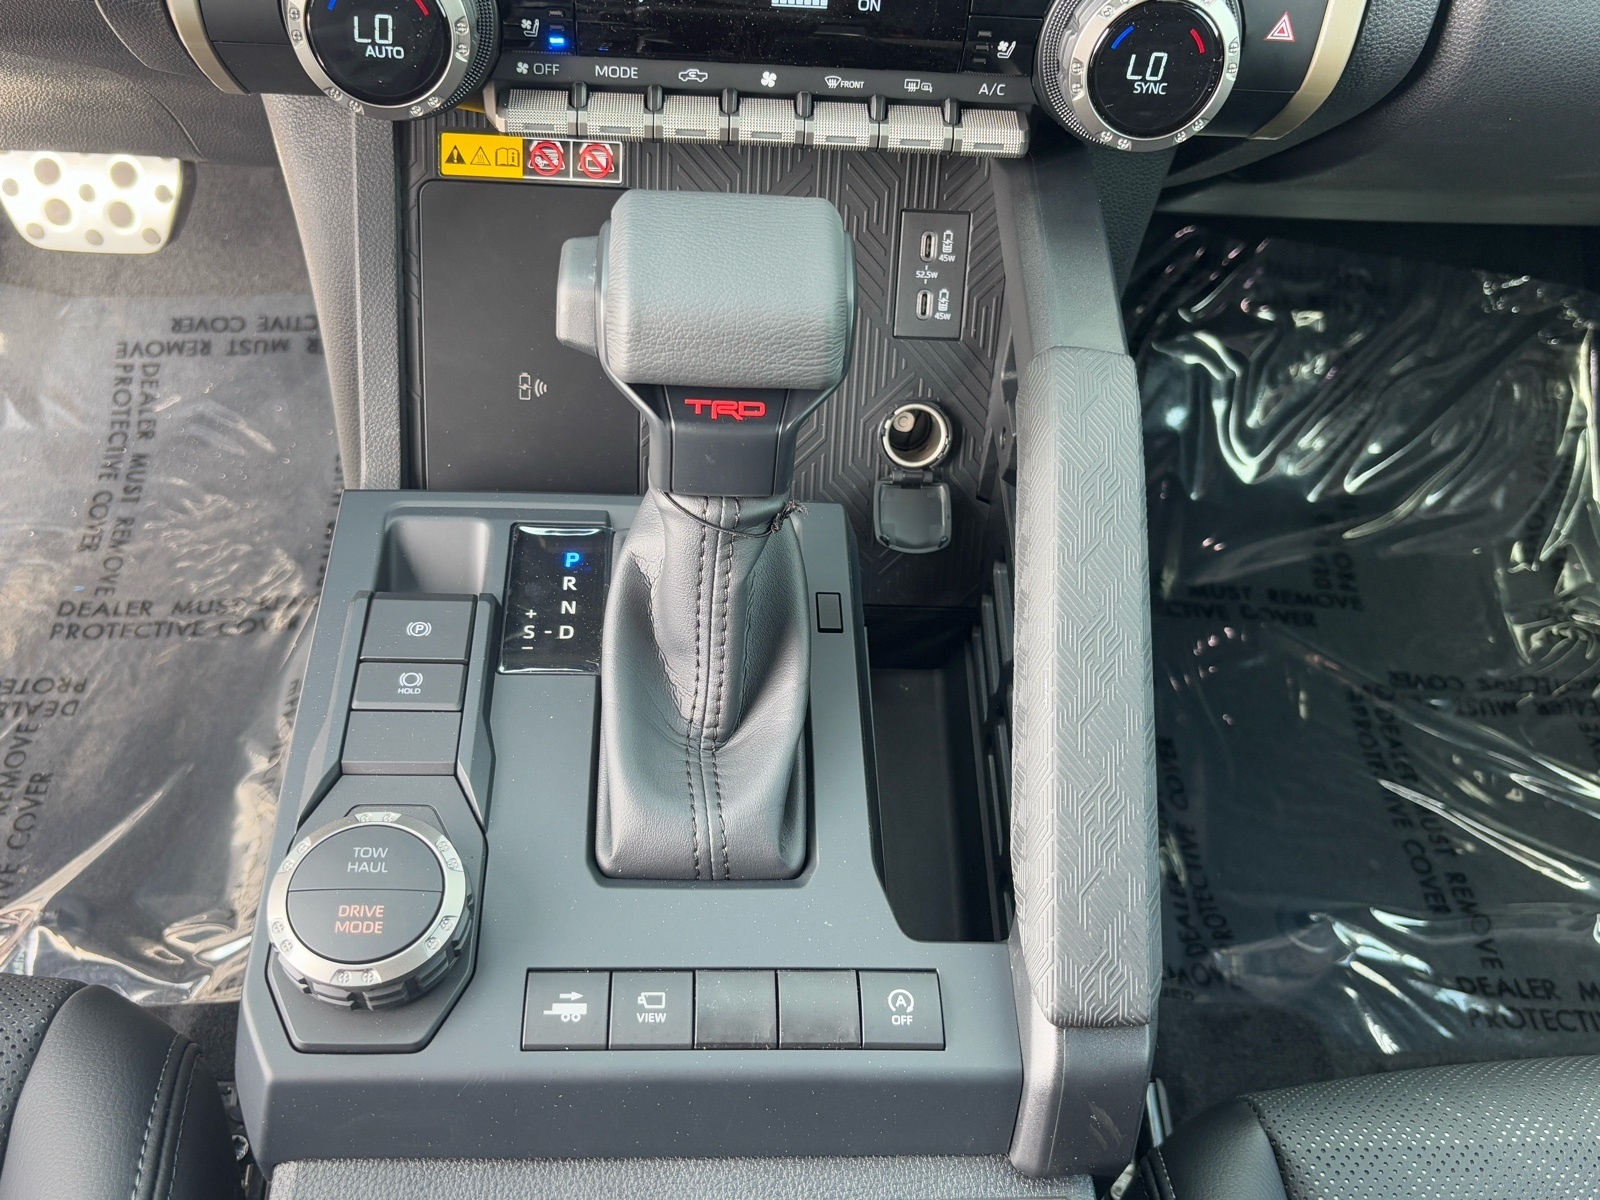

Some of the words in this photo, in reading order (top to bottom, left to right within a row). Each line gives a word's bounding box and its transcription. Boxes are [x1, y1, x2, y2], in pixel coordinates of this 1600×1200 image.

[858, 0, 881, 12] ON
[365, 46, 405, 60] AUTO
[533, 63, 560, 76] OFF
[595, 64, 639, 79] MODE
[840, 80, 865, 90] FRONT
[978, 83, 1006, 97] A/C
[1132, 82, 1168, 95] SYNC
[938, 254, 956, 262] 45W
[915, 270, 938, 279] 52.5W
[171, 314, 247, 334] COVER
[934, 312, 952, 321] 45W
[115, 339, 212, 359] REMOVE
[225, 337, 291, 357] MUST
[136, 362, 160, 440] DEALER
[684, 398, 767, 421] TRD
[97, 362, 135, 481] PROTECTIVE
[120, 453, 149, 504] MUST
[77, 489, 114, 553] COVER
[95, 515, 135, 597] REMOVE
[565, 552, 580, 568] P
[562, 576, 577, 591] R
[56, 599, 154, 618] DEALER
[560, 600, 576, 615] N
[50, 619, 205, 641] PROTECTIVE
[397, 687, 422, 695] HOLD
[7, 772, 53, 851] COVER
[353, 847, 389, 858] TOW
[347, 862, 389, 873] HAUL
[1403, 838, 1452, 915] COVER
[338, 905, 385, 917] DRIVE
[334, 921, 384, 934] MODE
[1444, 872, 1505, 970] REMOVE
[1455, 976, 1563, 1000] DEALER
[636, 1012, 667, 1023] VIEW
[892, 1015, 913, 1026] OFF
